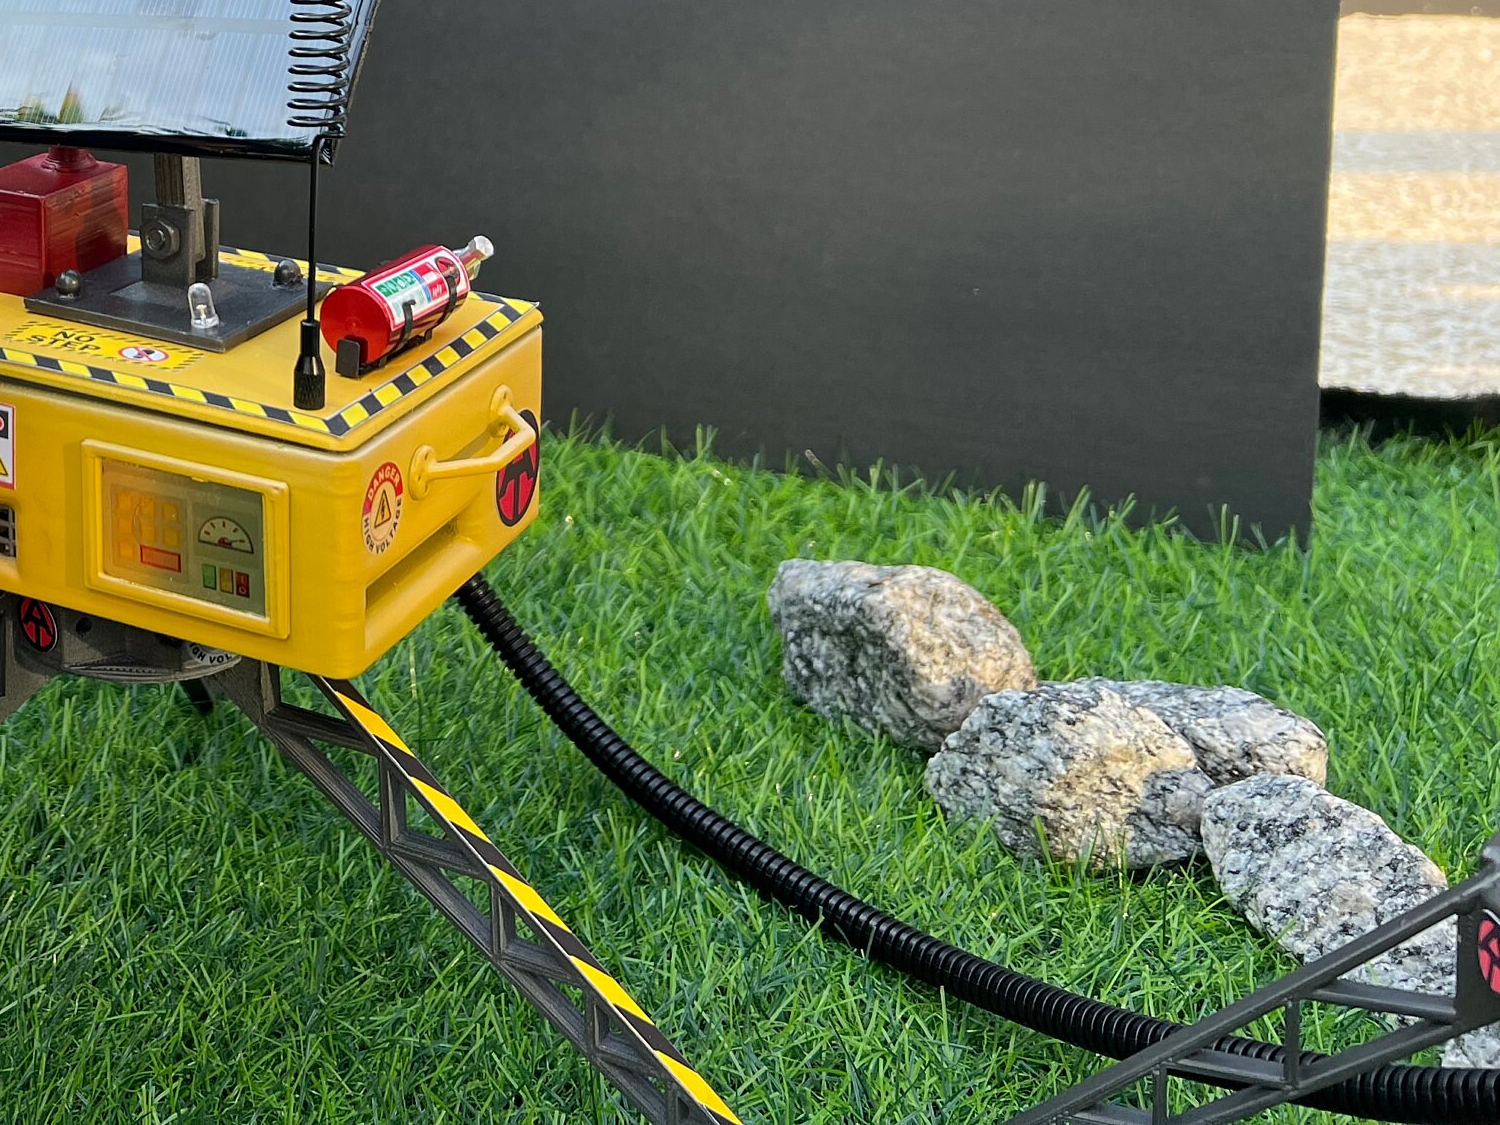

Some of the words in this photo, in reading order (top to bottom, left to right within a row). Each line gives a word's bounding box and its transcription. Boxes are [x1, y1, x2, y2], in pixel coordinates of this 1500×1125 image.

[26, 335, 101, 351] STEP
[53, 331, 95, 342] NO
[368, 466, 400, 500] DANGER
[363, 517, 375, 552] HIGH
[376, 498, 402, 554] VOLTAGE
